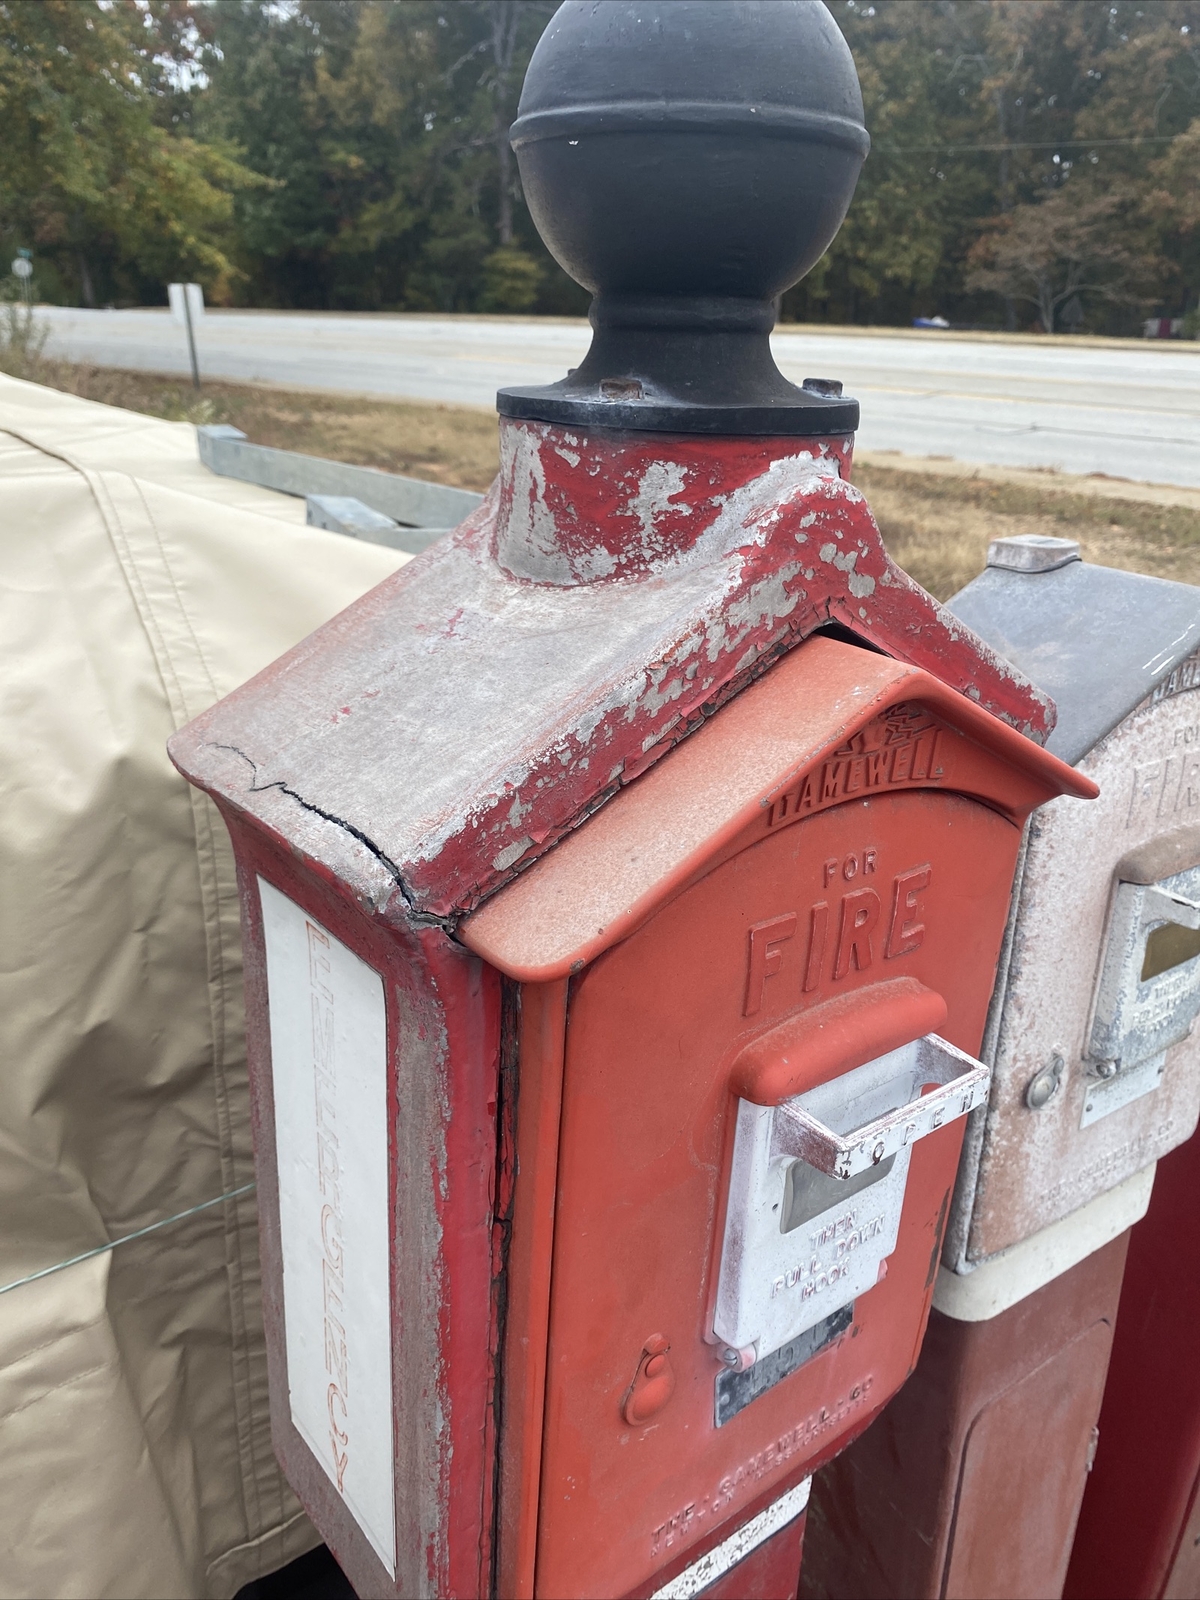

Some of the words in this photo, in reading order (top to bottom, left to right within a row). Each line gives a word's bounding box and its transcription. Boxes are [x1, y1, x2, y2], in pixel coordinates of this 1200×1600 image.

[823, 848, 877, 888] FOR
[742, 863, 931, 1016] FIRE
[871, 1090, 974, 1166] OPEN
[306, 920, 349, 1493] EMERGENCY
[810, 1208, 858, 1249] THEN
[771, 1254, 822, 1299] PULL
[834, 1213, 886, 1258] DOWN
[801, 1257, 850, 1300] HOOK
[651, 1503, 695, 1545] THE
[719, 1406, 831, 1494] GAMEWELL
